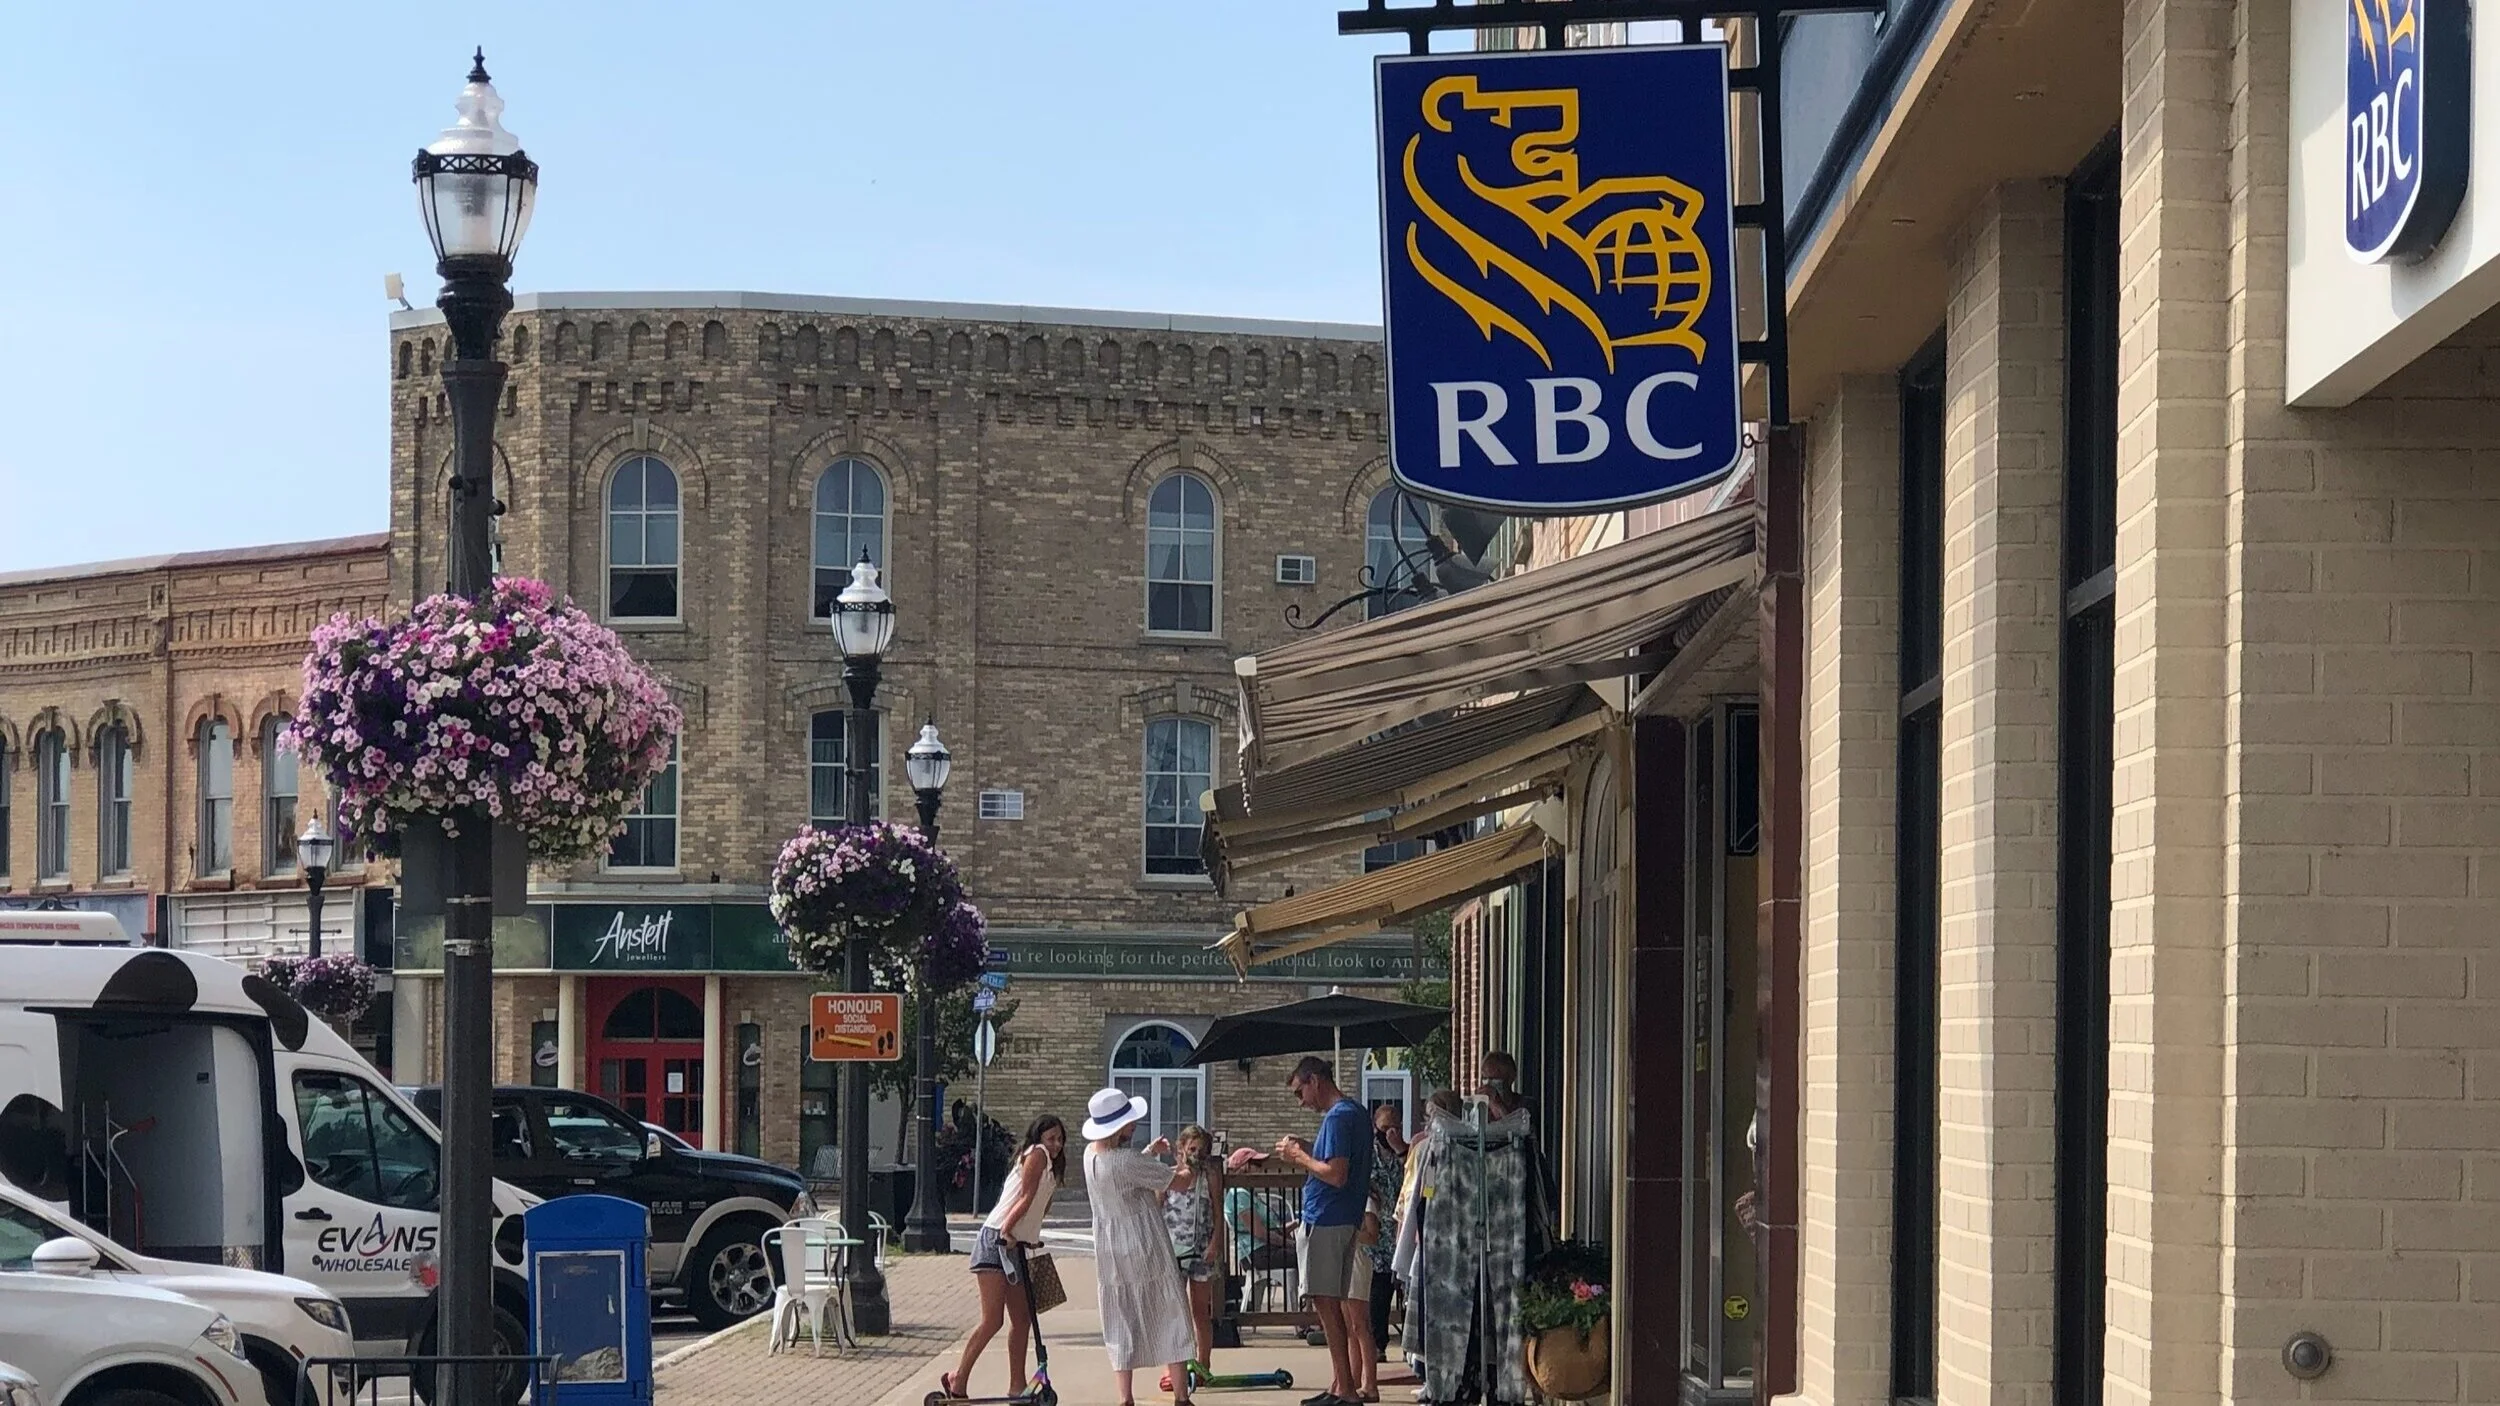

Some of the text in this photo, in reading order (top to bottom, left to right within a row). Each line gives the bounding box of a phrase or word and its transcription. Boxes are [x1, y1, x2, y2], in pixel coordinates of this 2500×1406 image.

[2352, 68, 2412, 221] RBC
[1429, 370, 1704, 468] RBC
[590, 910, 674, 963] Anstett
[1050, 948, 1114, 967] looking
[1120, 949, 1143, 965] for
[1149, 950, 1176, 966] the
[1181, 951, 1230, 969] perfec
[1328, 952, 1363, 969] look
[1370, 954, 1385, 969] to
[827, 1000, 883, 1014] HONOUR
[834, 1024, 877, 1034] DISTANCING
[842, 1014, 868, 1024] SOCIAL
[318, 1212, 439, 1253] EVANS
[319, 1258, 412, 1273] WHOLESALE
